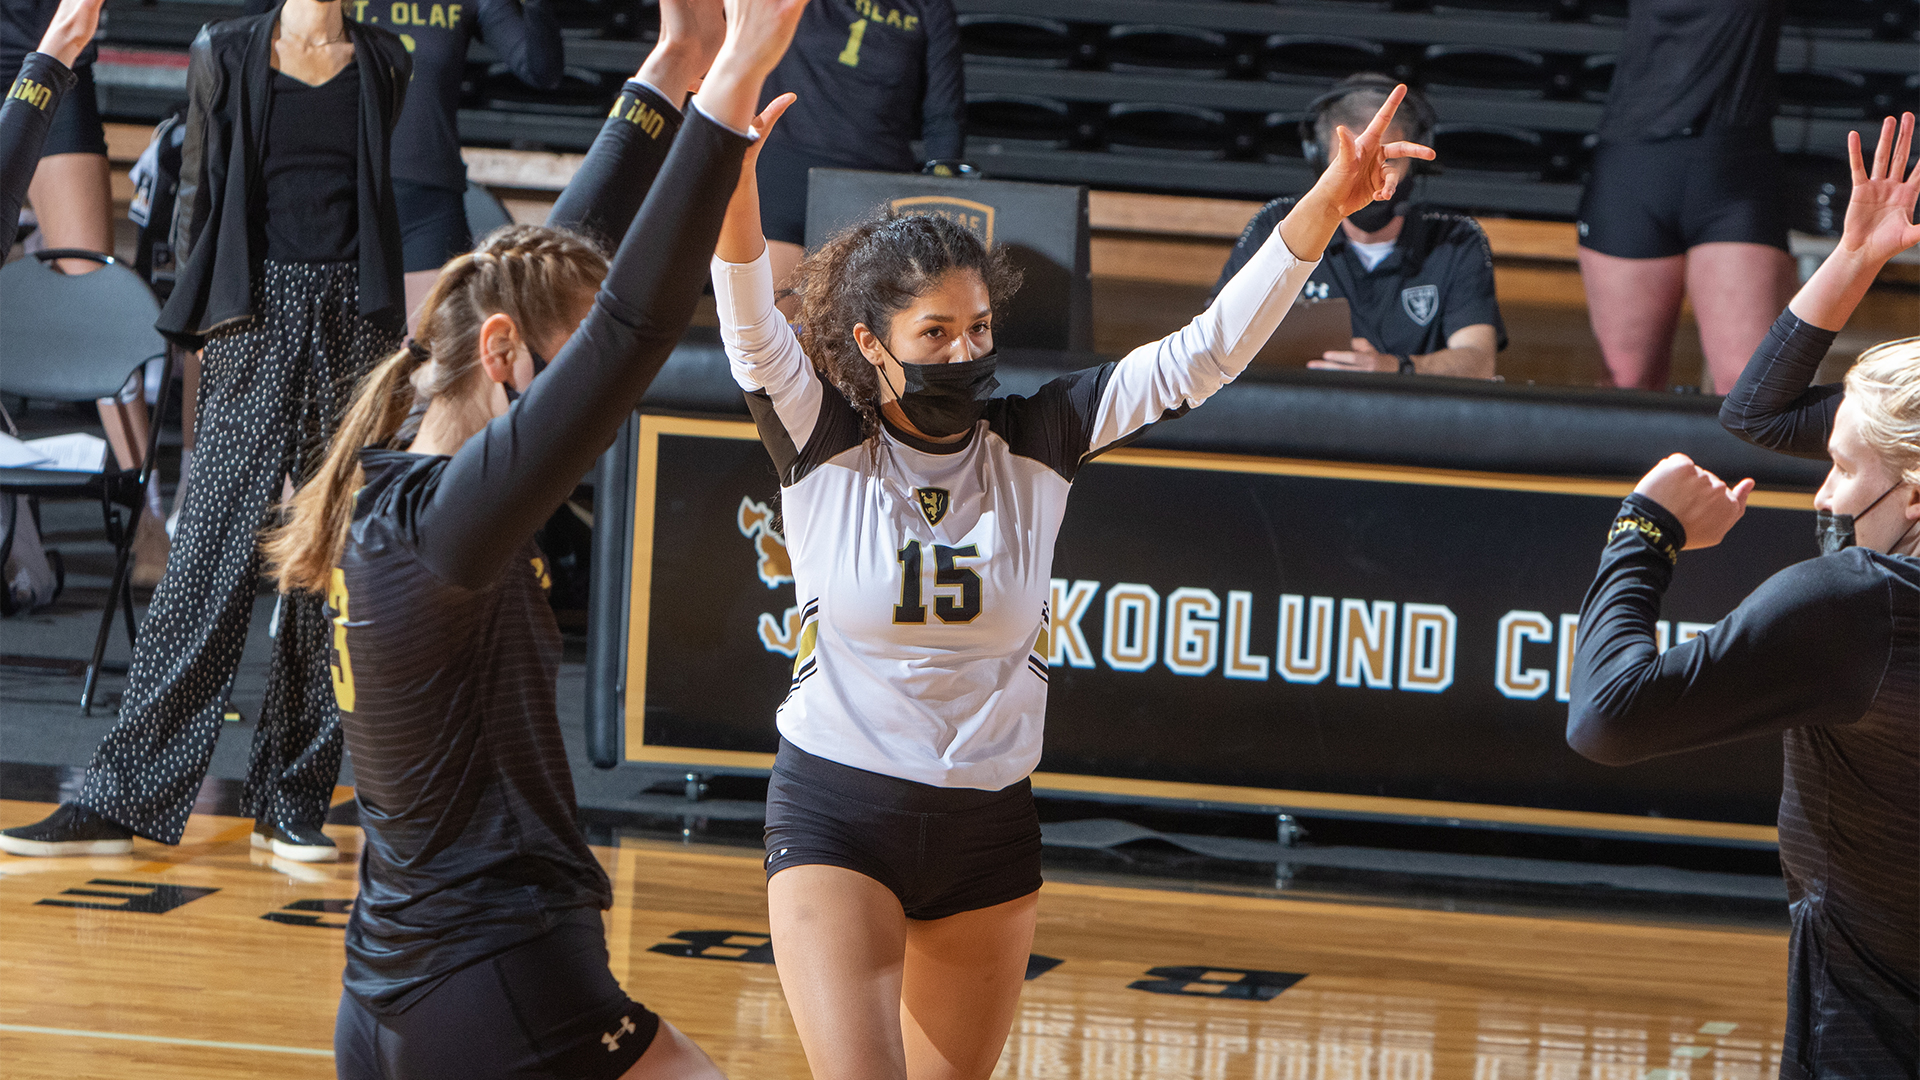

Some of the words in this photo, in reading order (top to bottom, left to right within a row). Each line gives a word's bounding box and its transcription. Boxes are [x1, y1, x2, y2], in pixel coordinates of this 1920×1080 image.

[353, 0, 379, 24] T.
[390, 2, 463, 29] OLAF
[838, 18, 867, 68] 1
[892, 538, 983, 625] 15
[1048, 578, 1458, 694] KOGLUND
